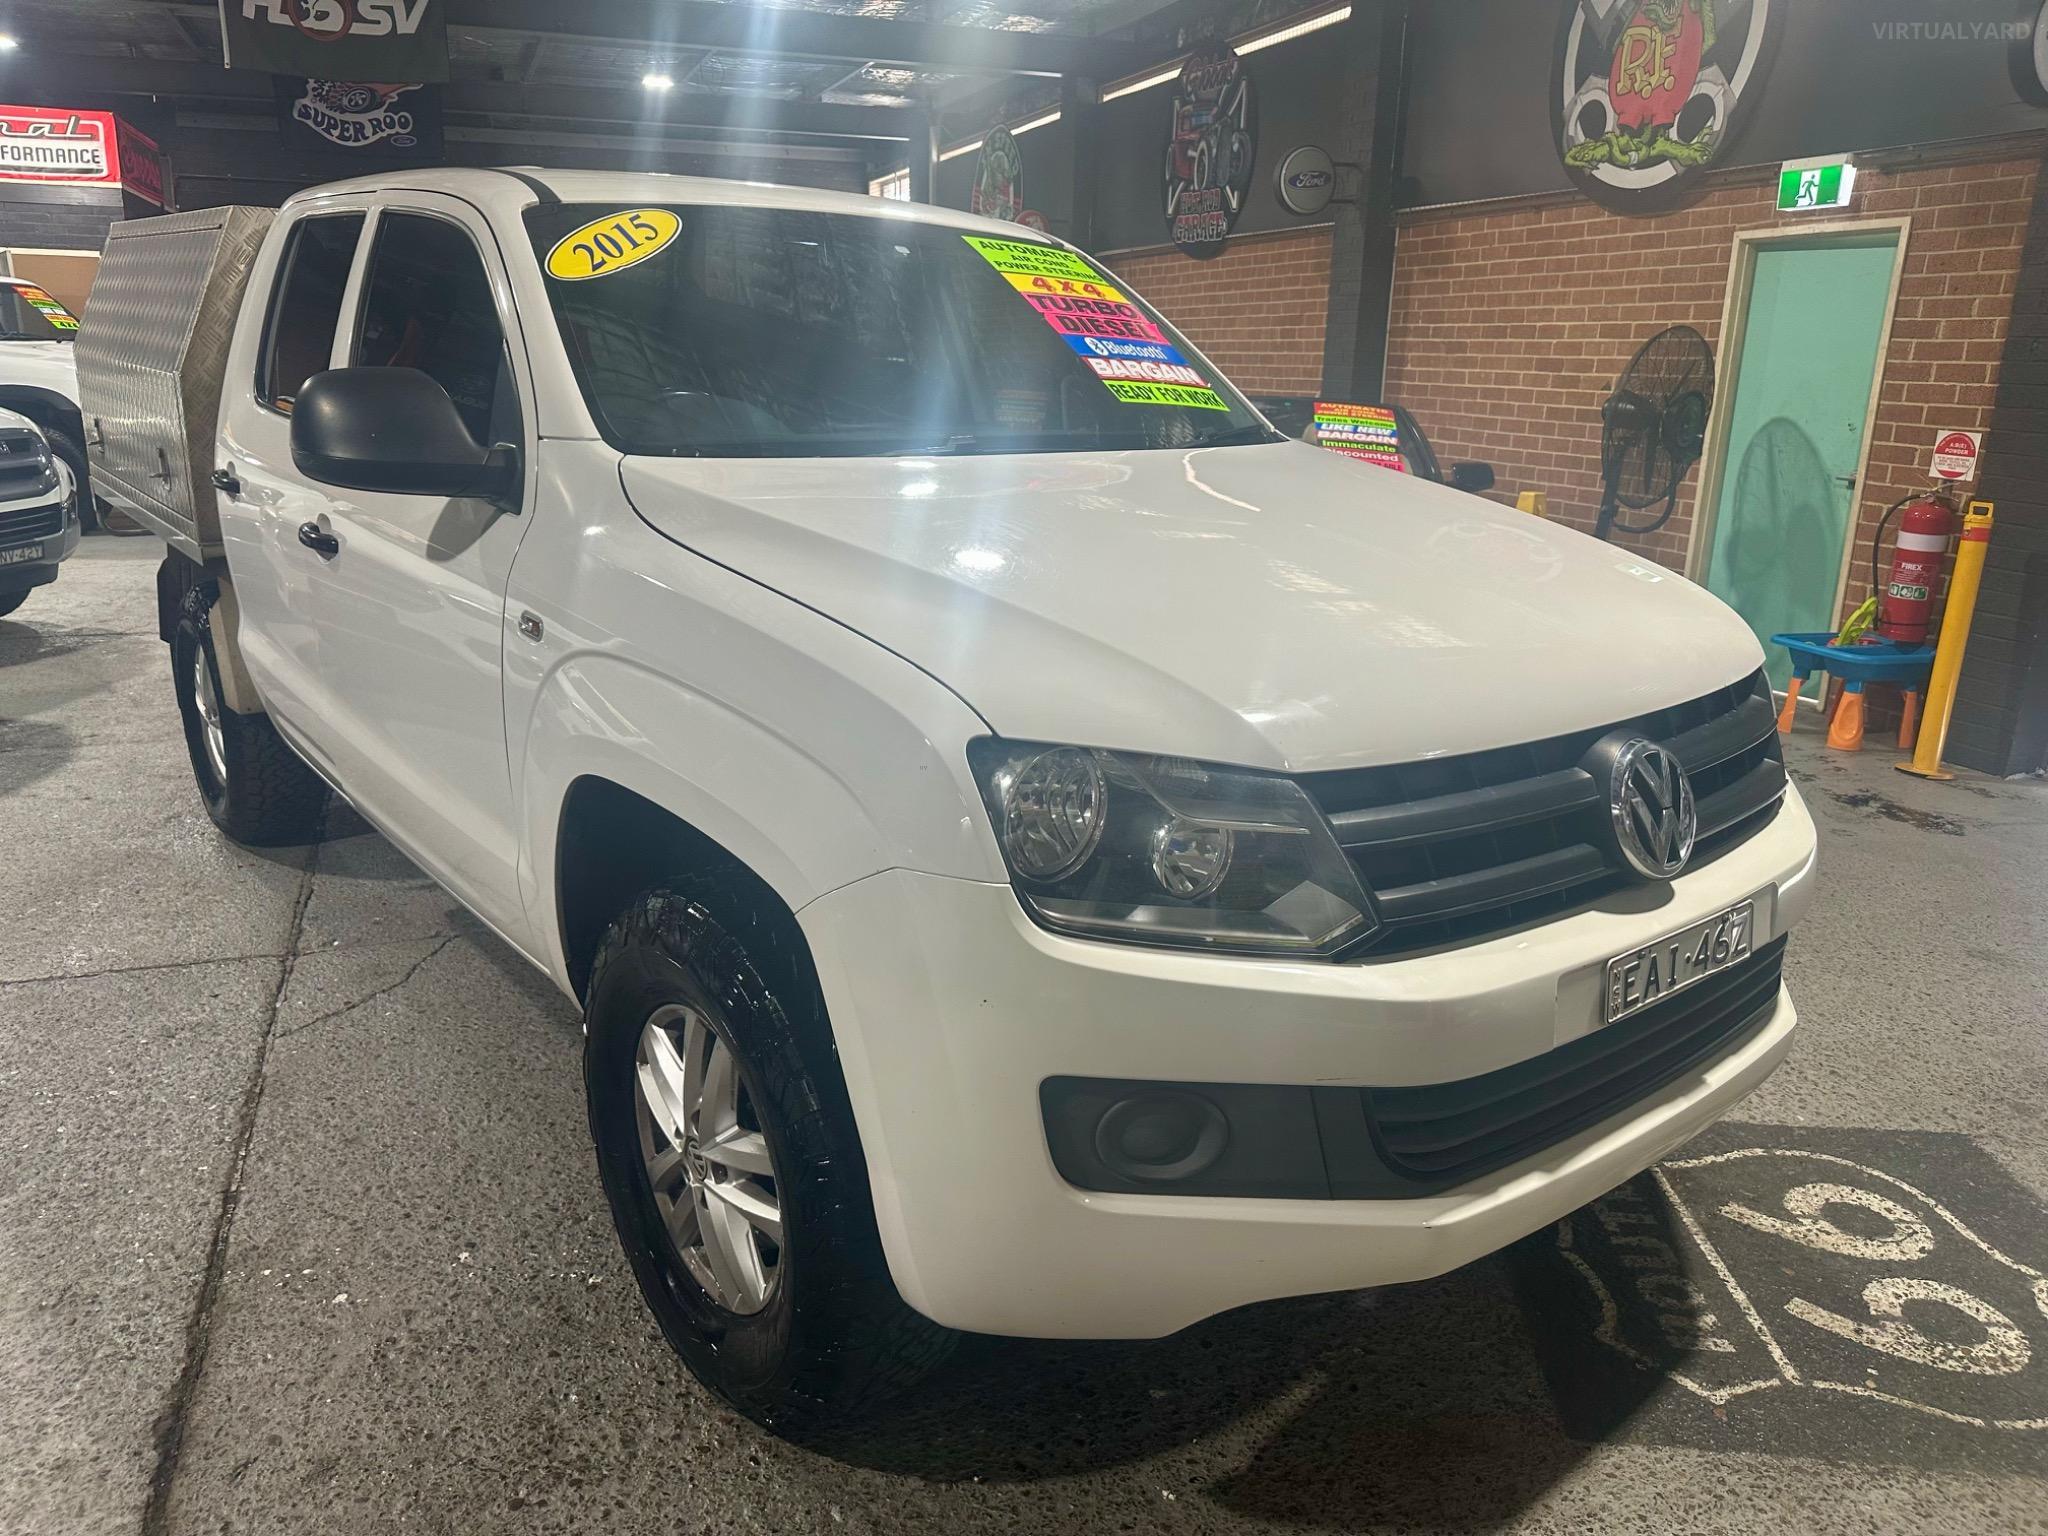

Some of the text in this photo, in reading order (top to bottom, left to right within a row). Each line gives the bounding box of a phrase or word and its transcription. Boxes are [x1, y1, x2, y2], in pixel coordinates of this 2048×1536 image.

[298, 103, 412, 142] SUPER ROO
[1296, 172, 1326, 188] Ford
[573, 213, 659, 273] 2015
[979, 240, 1078, 264] AUTOMATIC
[1011, 254, 1034, 263] AIR
[993, 260, 1105, 282] POWER STEERING
[1027, 294, 1139, 320] TURBO
[1059, 314, 1157, 340] DIESEL
[1103, 339, 1165, 361] Bluetooth
[1087, 357, 1201, 385] BARGAIN
[1109, 384, 1226, 408] READY FOR WORK
[1320, 402, 1389, 414] AUTOMATIC
[1317, 430, 1398, 446] BARGAIN
[1321, 423, 1393, 436] LIKE NEW
[1322, 440, 1396, 453] Immaculate
[1901, 562, 1922, 571] FIREX
